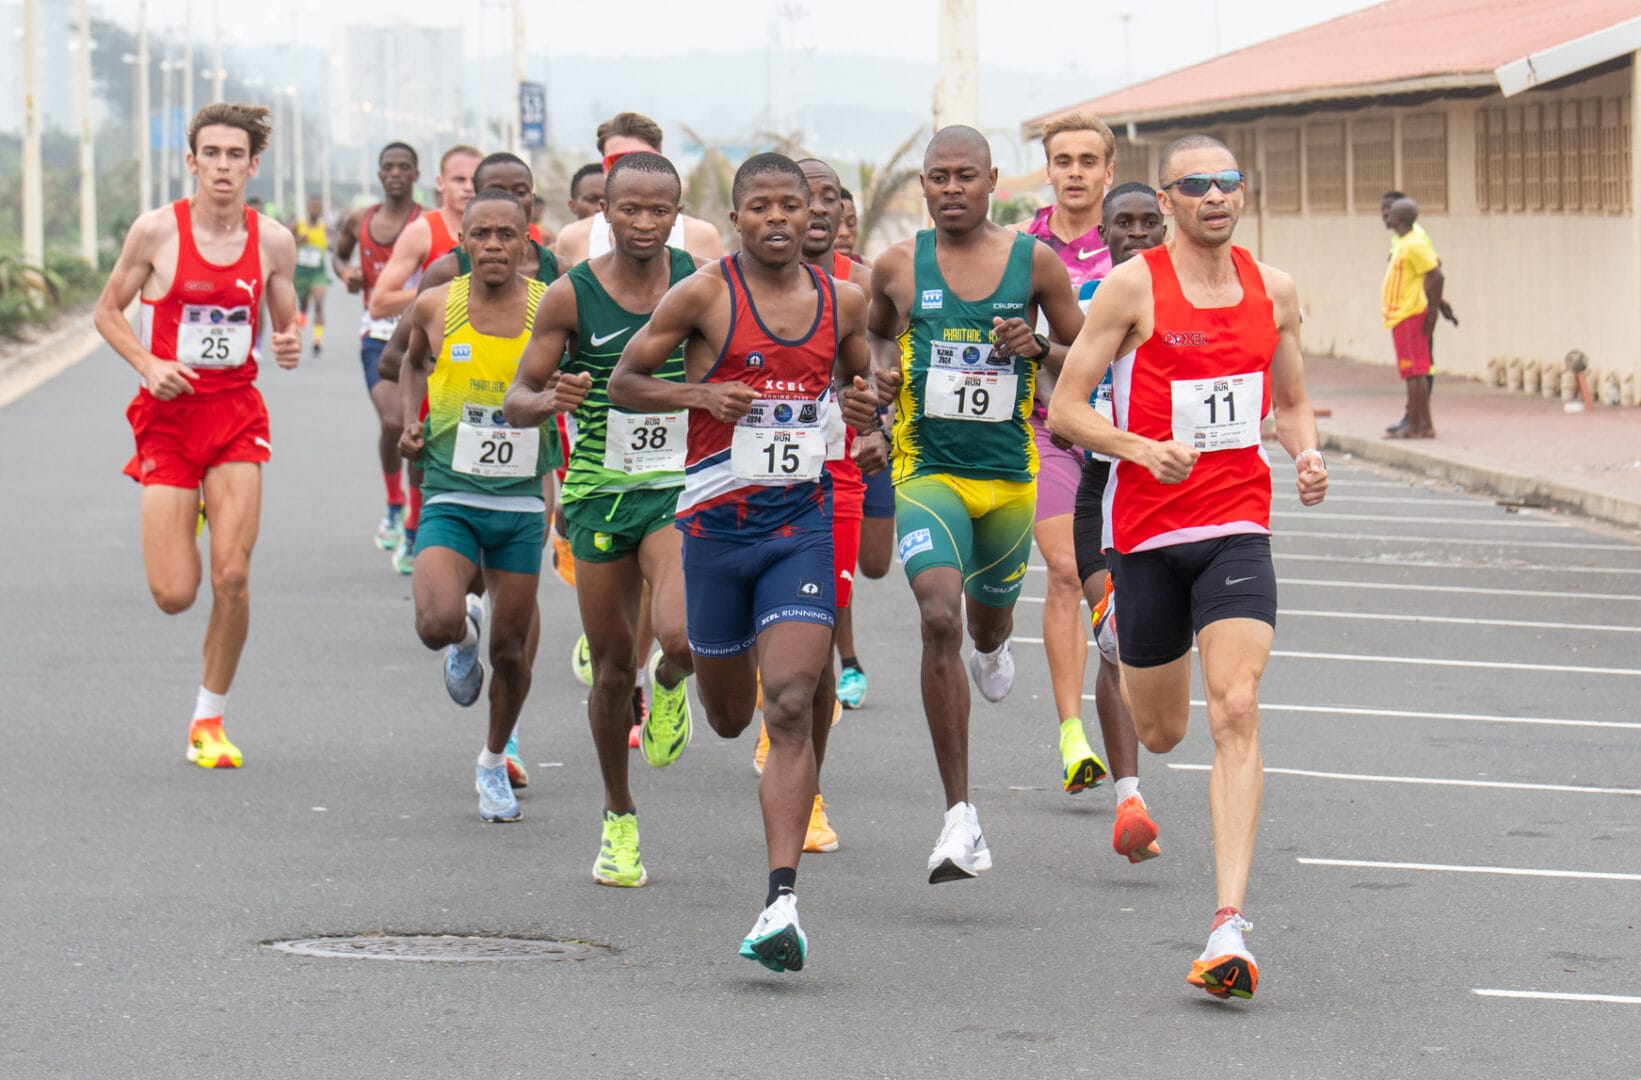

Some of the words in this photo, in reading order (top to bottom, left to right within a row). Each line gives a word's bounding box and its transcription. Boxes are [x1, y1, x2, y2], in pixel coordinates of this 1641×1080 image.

[944, 328, 981, 342] PHANTANE
[201, 337, 229, 359] 25
[765, 380, 806, 392] XCEL
[954, 387, 989, 415] 19
[1204, 392, 1235, 424] 11
[631, 426, 667, 450] 38
[773, 433, 791, 442] RUN
[480, 440, 513, 464] 20
[762, 443, 800, 473] 15
[782, 609, 828, 621] RUNNING
[697, 645, 741, 656] RUNNING
